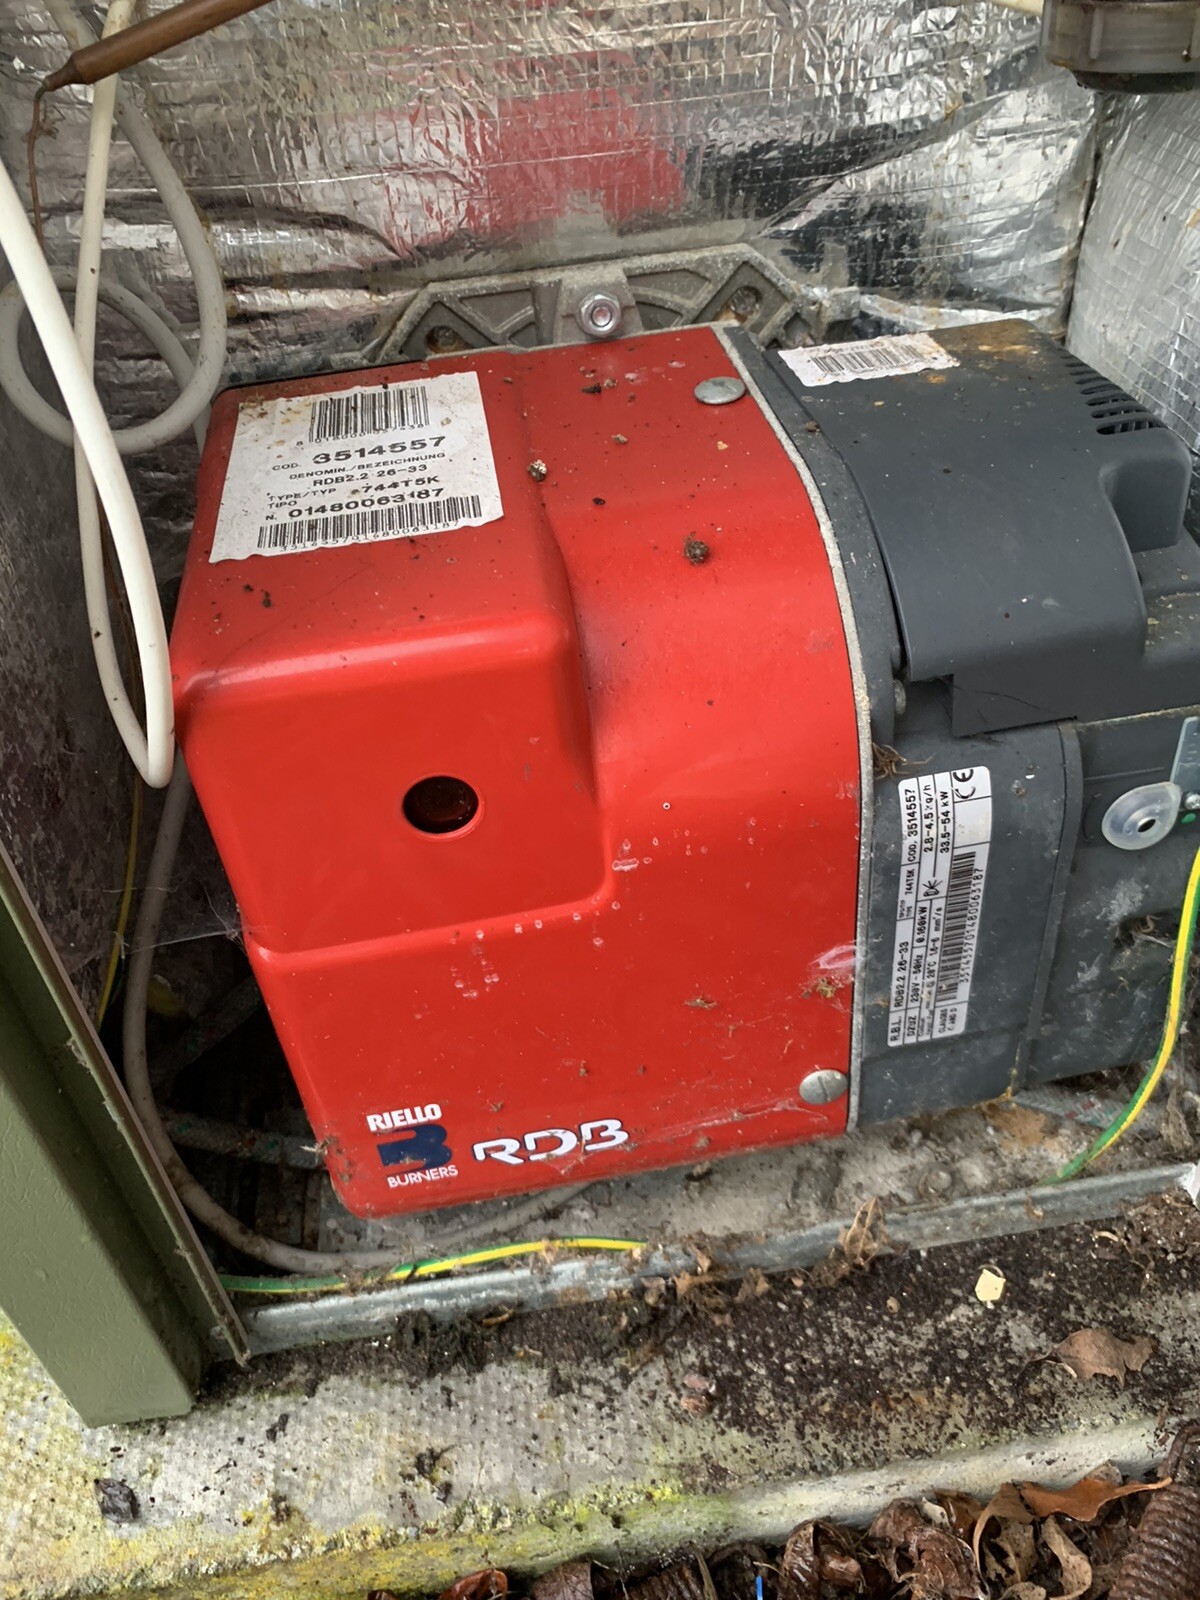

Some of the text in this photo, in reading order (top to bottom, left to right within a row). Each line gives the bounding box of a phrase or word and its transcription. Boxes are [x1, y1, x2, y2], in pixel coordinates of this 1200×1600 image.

[312, 435, 447, 465] 3514557
[268, 475, 440, 502] TYPE/TYP 744T5K
[313, 463, 428, 487] RDB2.2 26-33
[267, 500, 297, 510] TIPO
[288, 488, 445, 518] 01480063187
[904, 788, 917, 837] 3514557
[940, 810, 950, 854] 33.5-54
[905, 868, 915, 895] 744T5K
[894, 941, 910, 1008] RDB2.2 26-33
[912, 953, 924, 974] 50Hz
[910, 982, 920, 1004] 230V
[890, 1016, 903, 1041] R.B.L.
[367, 1103, 442, 1132] RIELLO
[472, 1118, 630, 1165] RDB
[387, 1164, 459, 1188] BURNERS
